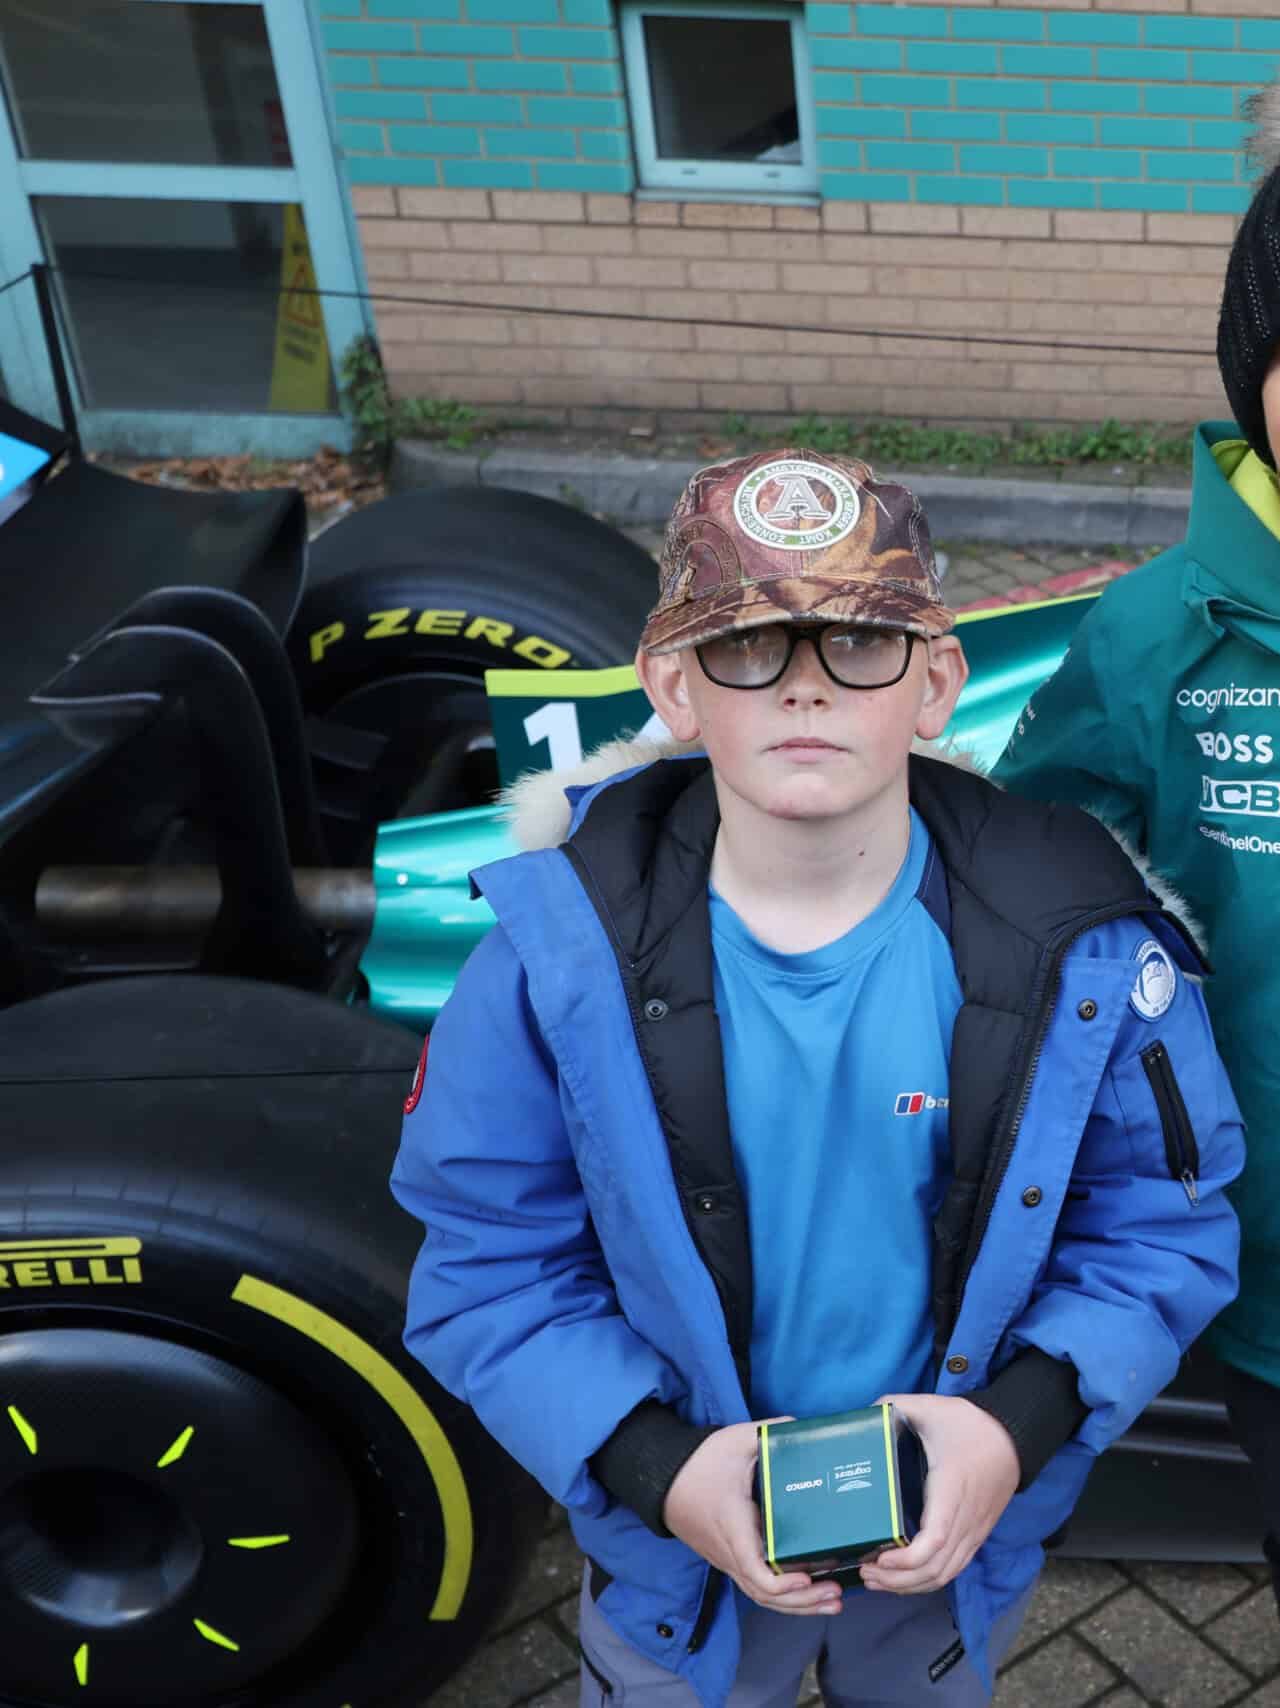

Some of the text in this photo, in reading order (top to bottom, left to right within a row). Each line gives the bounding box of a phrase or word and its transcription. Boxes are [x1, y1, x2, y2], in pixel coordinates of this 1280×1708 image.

[764, 475, 831, 520] A
[309, 607, 572, 669] P ZERO
[1195, 731, 1274, 764] BOSS
[785, 1479, 823, 1491] aramco
